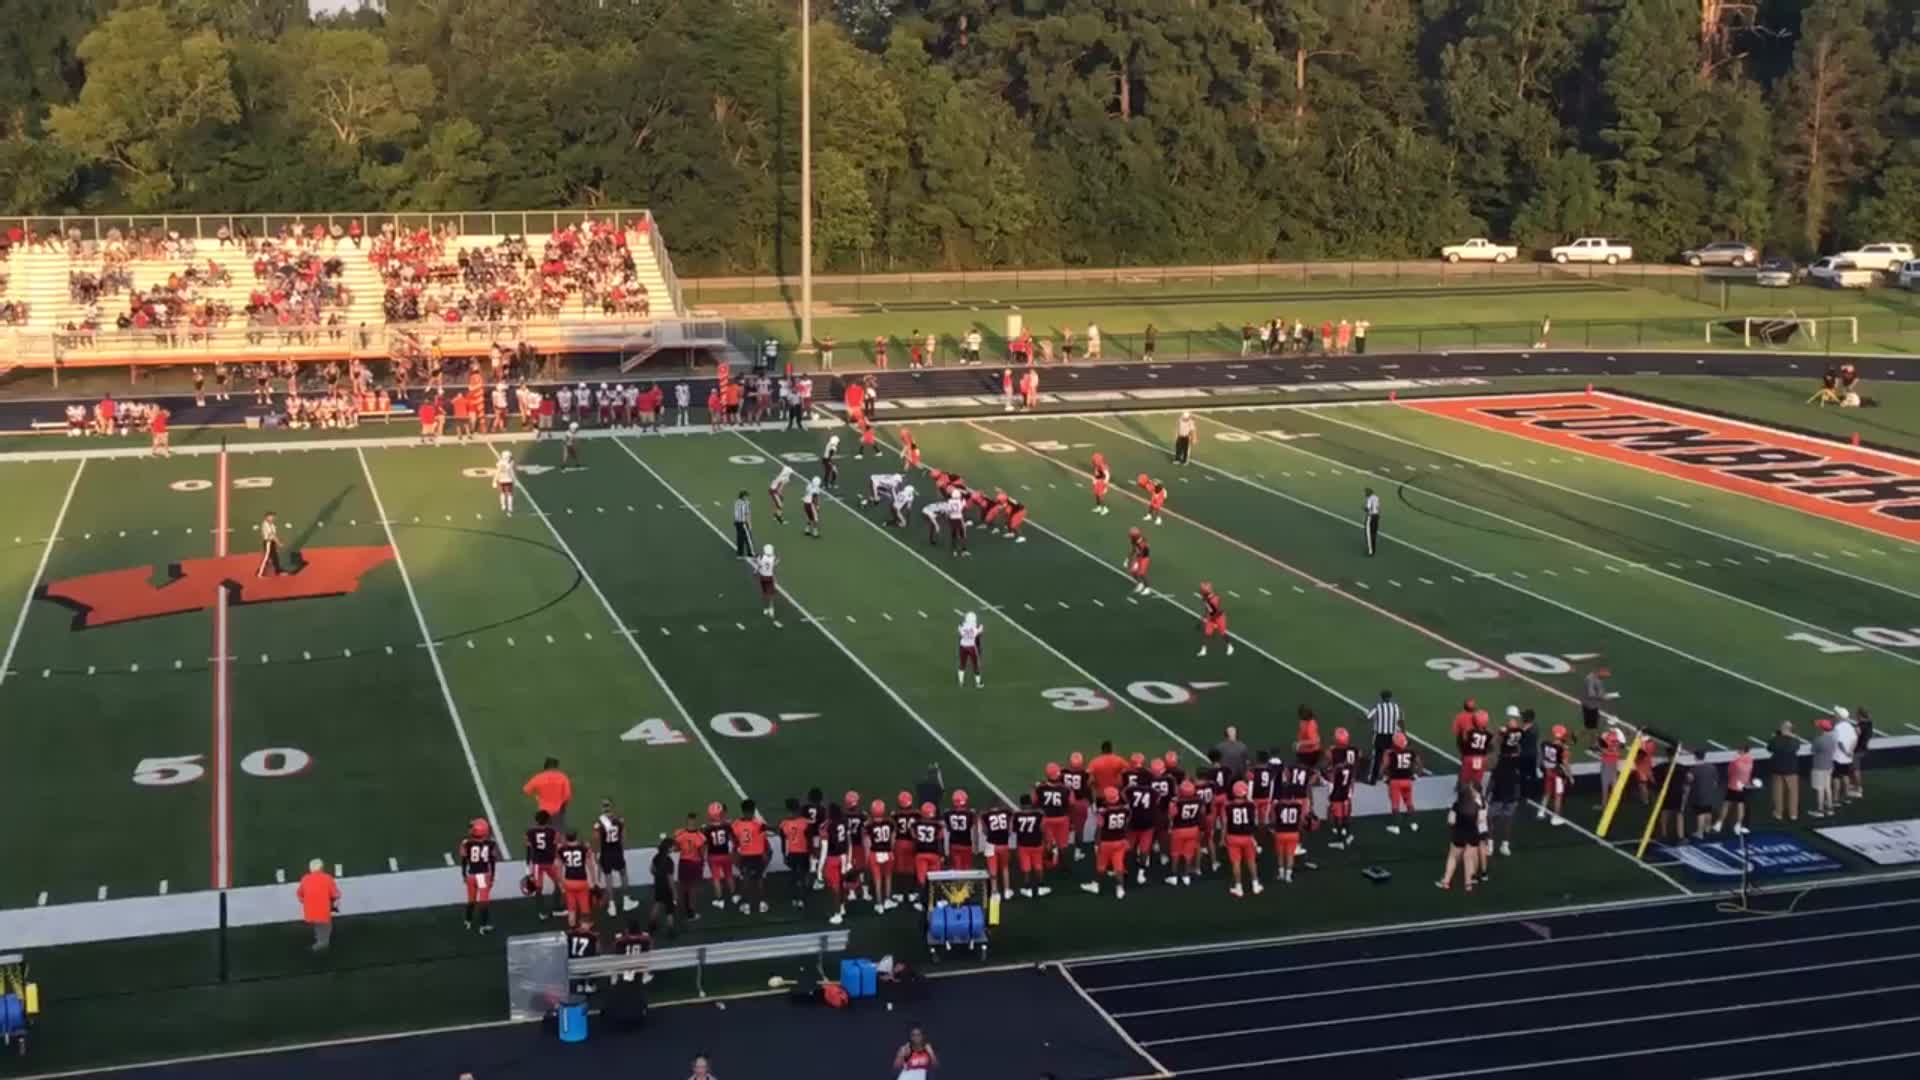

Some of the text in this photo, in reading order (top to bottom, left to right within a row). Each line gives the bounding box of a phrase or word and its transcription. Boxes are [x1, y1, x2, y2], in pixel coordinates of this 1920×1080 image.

[1465, 403, 1920, 522] LUMBER
[1472, 733, 1487, 750] 31
[1397, 753, 1412, 768] 15
[1261, 771, 1269, 786] 9
[1043, 791, 1062, 806] 76
[1133, 792, 1151, 808] 74
[1182, 804, 1199, 819] 67
[1232, 807, 1248, 824] 81
[1281, 807, 1298, 824] 40
[989, 813, 1007, 831] 26
[1018, 816, 1036, 832] 77
[535, 832, 546, 850] 5
[873, 825, 890, 842] 30
[917, 825, 935, 842] 53
[470, 845, 489, 862] 84
[563, 850, 582, 867] 32
[571, 937, 589, 956] 17
